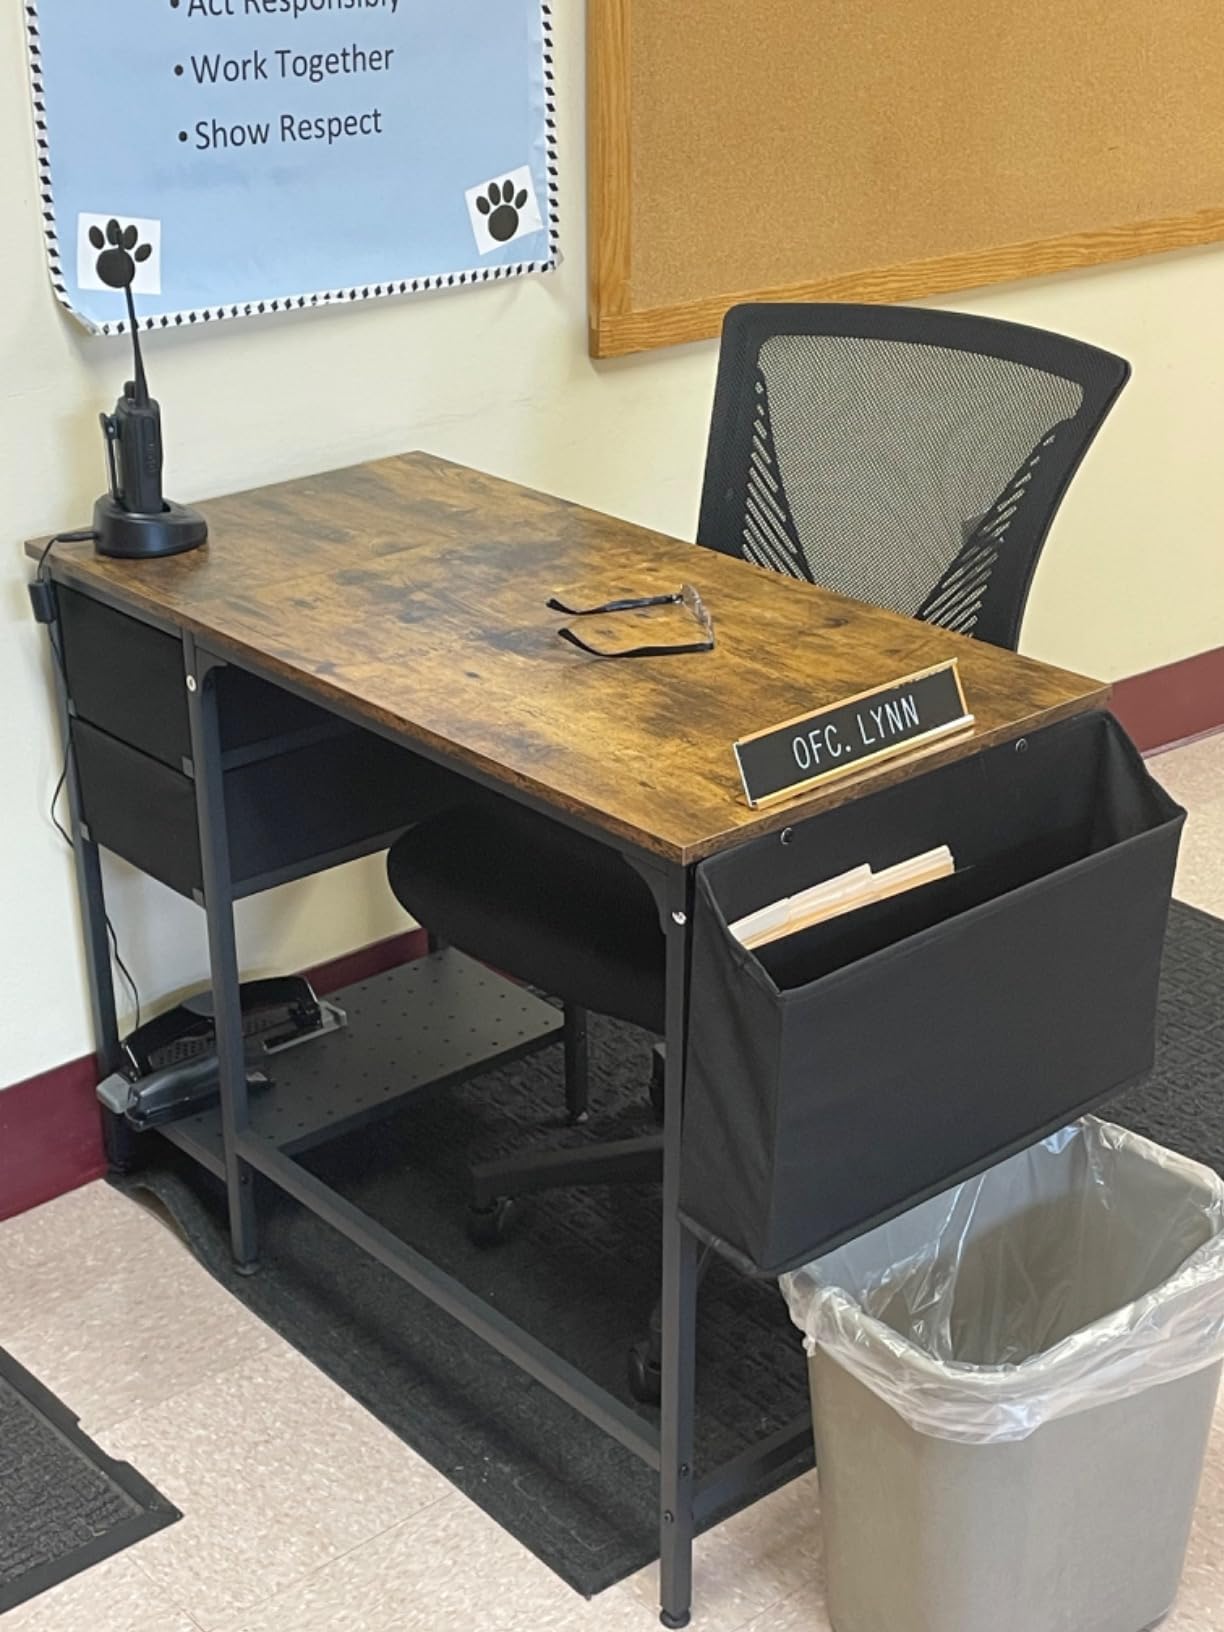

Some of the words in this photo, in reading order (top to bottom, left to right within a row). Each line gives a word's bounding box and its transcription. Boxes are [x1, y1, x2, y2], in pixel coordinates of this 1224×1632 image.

[187, 0, 234, 17] Act
[244, 0, 398, 19] Responsy
[190, 49, 268, 84] Work
[275, 43, 395, 83] Together
[195, 118, 270, 150] Show
[280, 108, 382, 145] Respect
[792, 724, 852, 769] OFC.
[856, 694, 920, 745] LYNN
